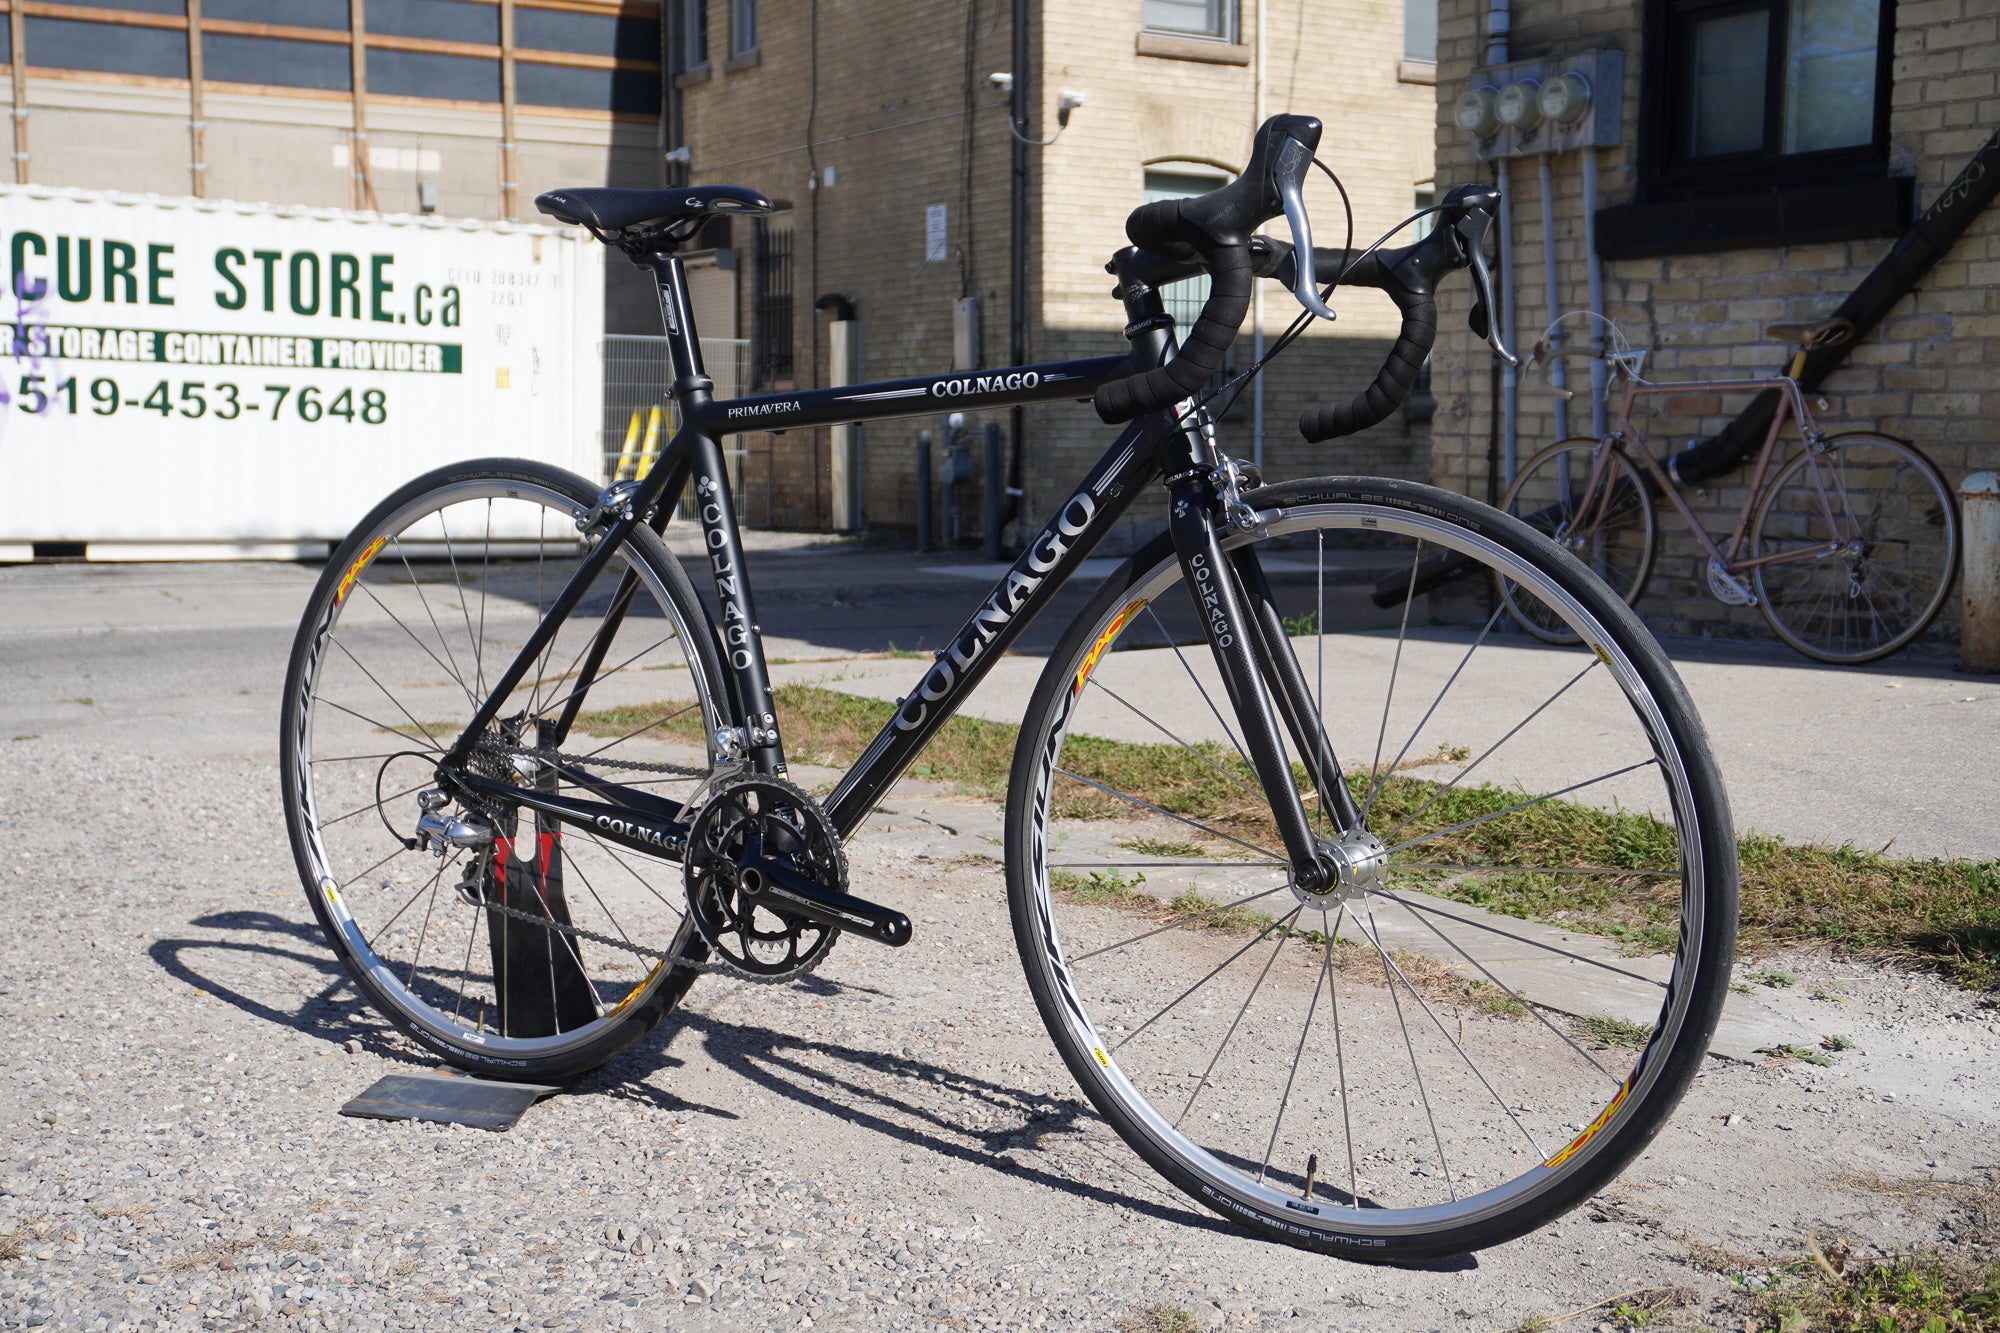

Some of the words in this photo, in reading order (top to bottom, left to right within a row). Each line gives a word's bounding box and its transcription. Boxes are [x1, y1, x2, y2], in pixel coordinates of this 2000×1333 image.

[11, 231, 175, 304] CURE
[214, 247, 460, 327] STORE.ca
[28, 325, 156, 361] STORAGE
[164, 331, 315, 367] CONTAINER
[322, 339, 443, 372] PROVIDER
[18, 375, 388, 425] 519-453-7648
[932, 371, 1039, 398] COLNAGO
[728, 401, 801, 418] PRIMAVERA
[1283, 492, 1384, 504] SCHWALBE
[703, 503, 752, 670] COLNAGO
[1191, 553, 1233, 648] COLNAGO
[895, 492, 1096, 731] COLNAGO
[1077, 599, 1147, 687] RACE
[464, 1051, 527, 1067] SCHWALBE
[1289, 1226, 1386, 1247] SCHWALBE
